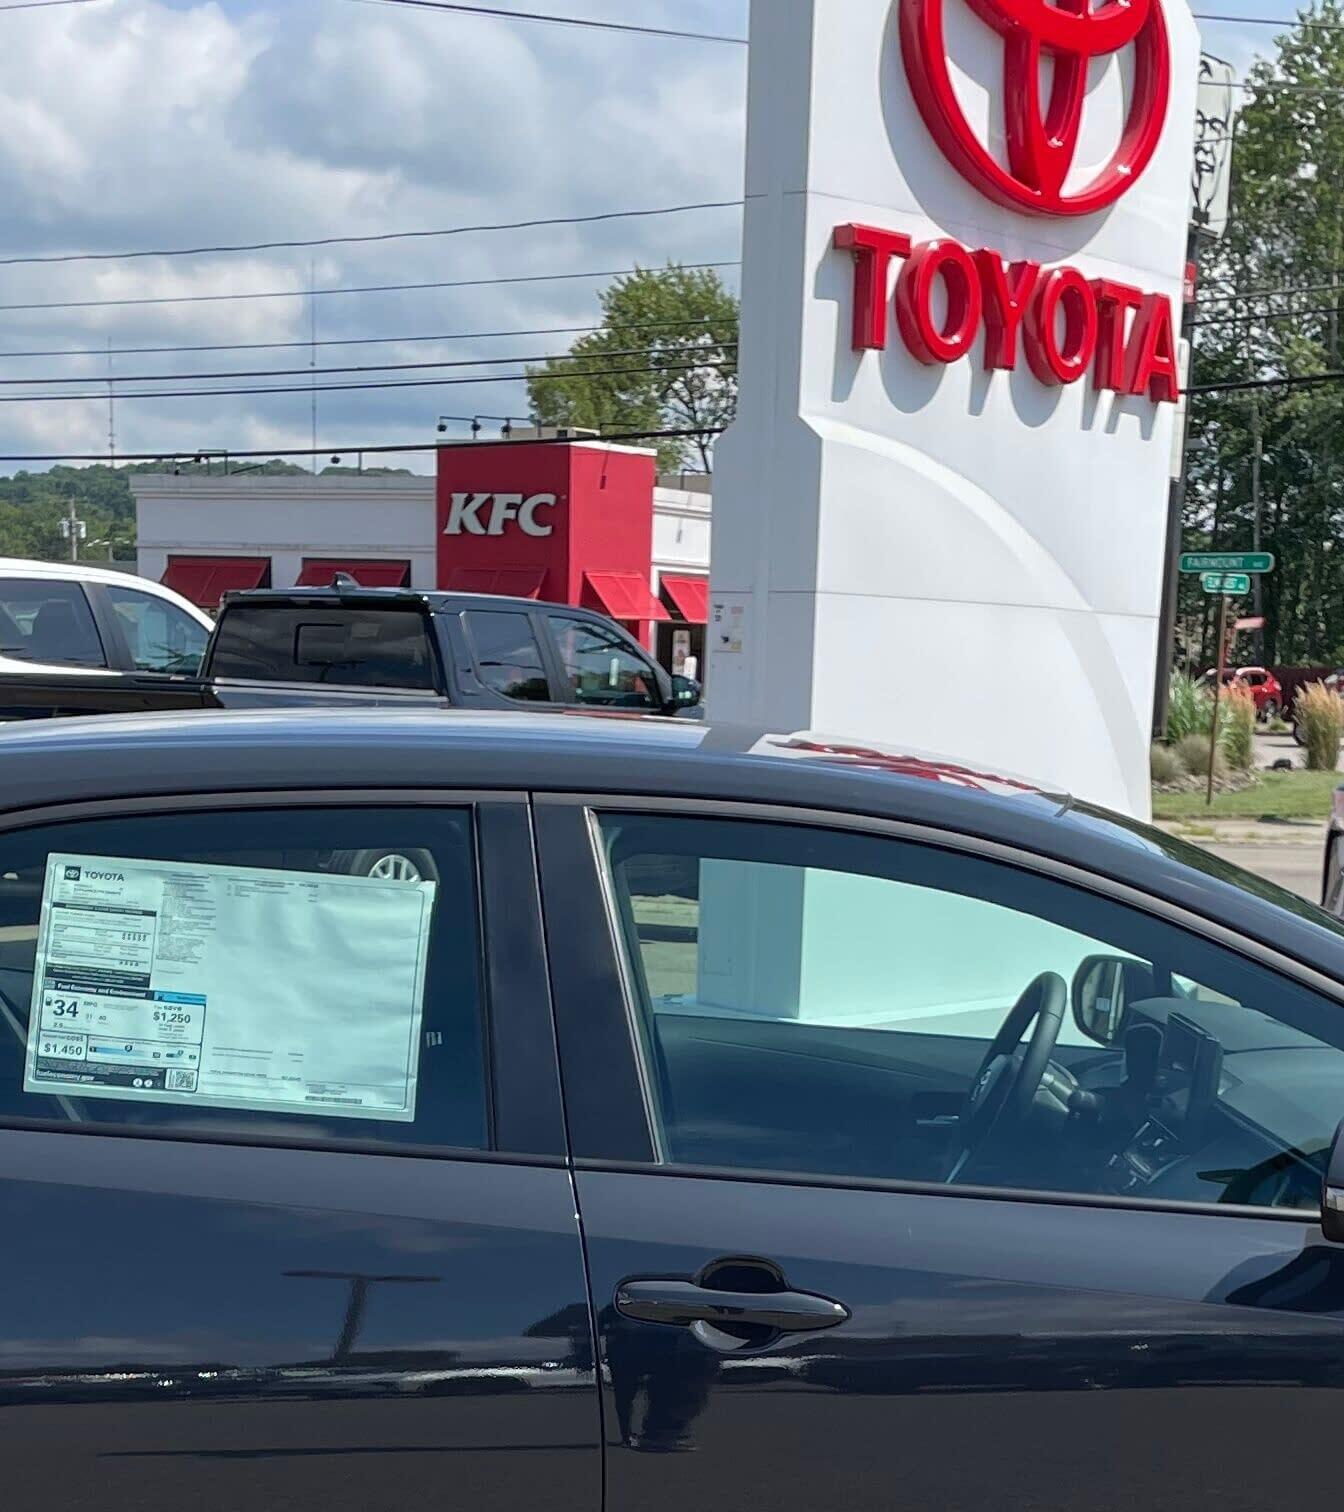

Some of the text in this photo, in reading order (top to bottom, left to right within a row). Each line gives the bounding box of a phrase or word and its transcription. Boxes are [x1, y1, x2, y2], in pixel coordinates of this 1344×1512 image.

[834, 222, 1179, 404] TOYOTA
[442, 492, 557, 537] KFC
[84, 869, 125, 882] TOYOTA
[52, 999, 79, 1018] 34
[152, 1011, 192, 1024] $1,250
